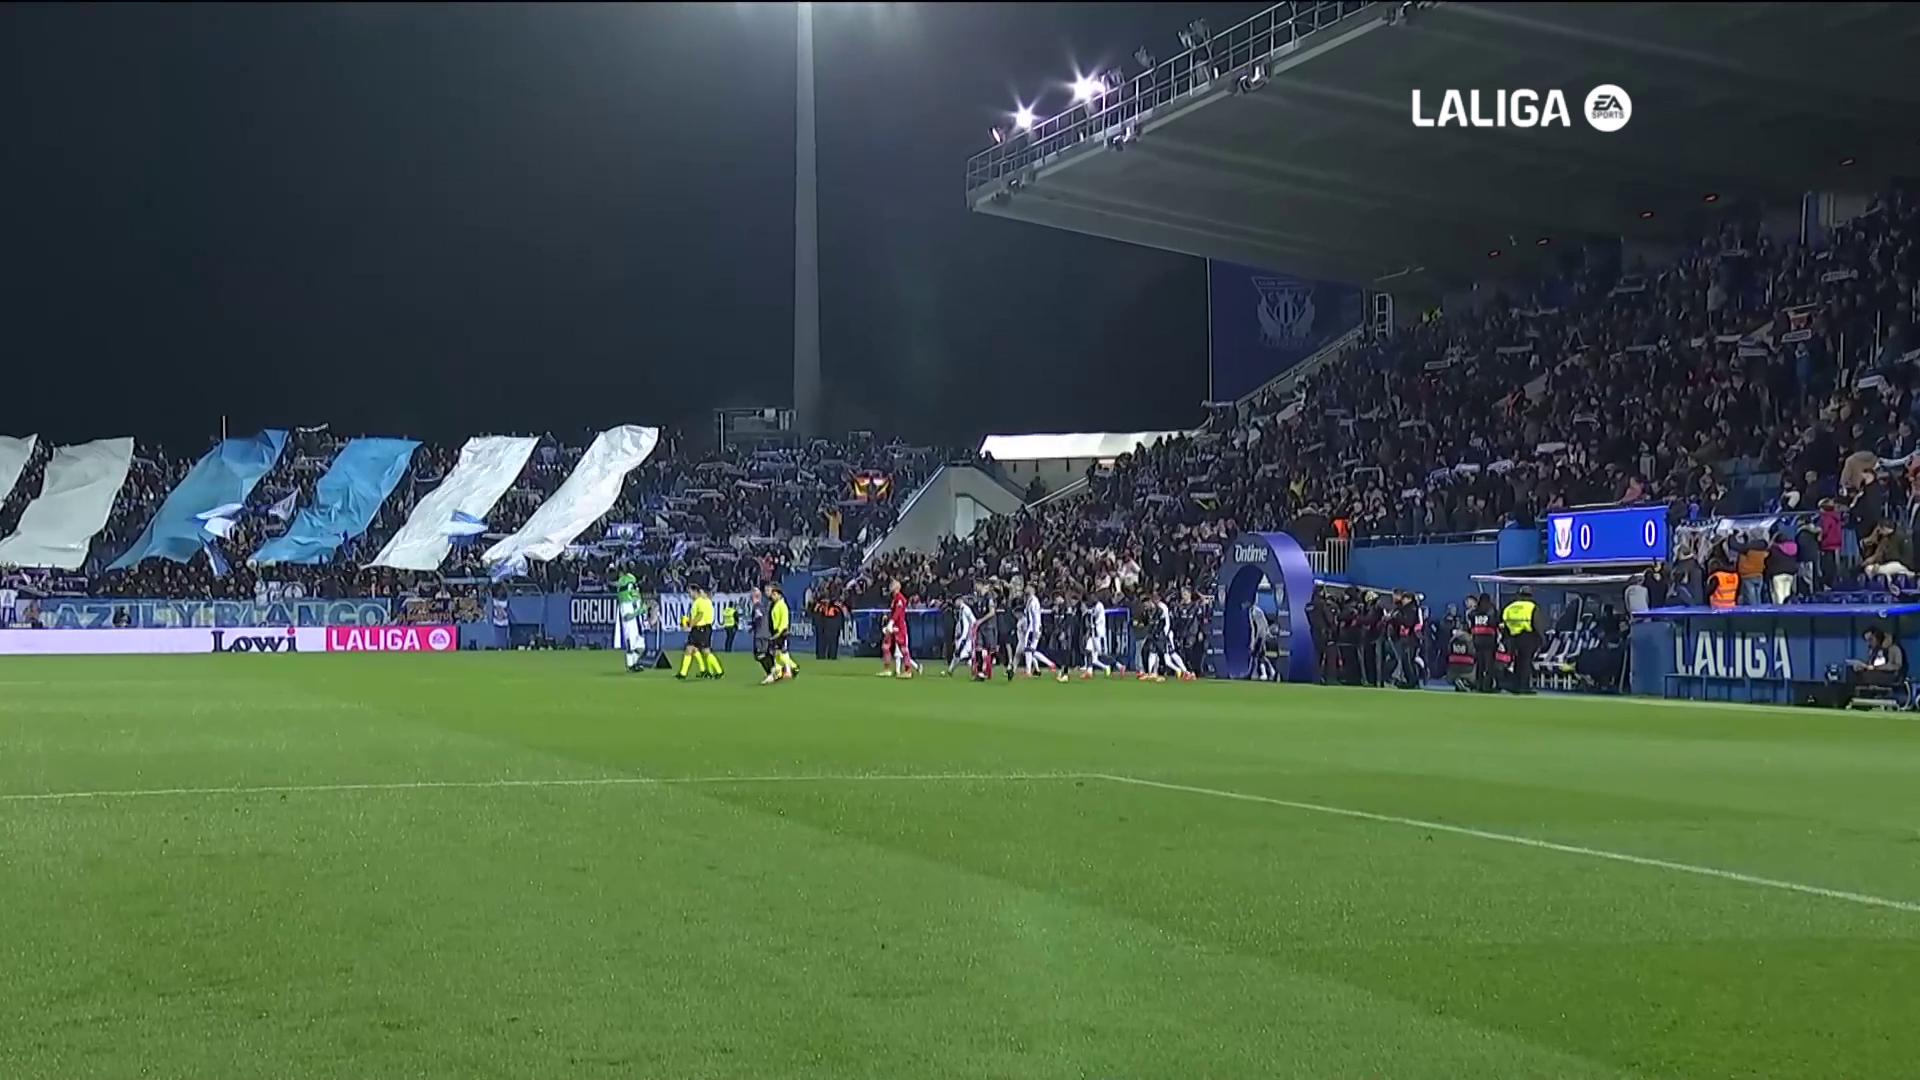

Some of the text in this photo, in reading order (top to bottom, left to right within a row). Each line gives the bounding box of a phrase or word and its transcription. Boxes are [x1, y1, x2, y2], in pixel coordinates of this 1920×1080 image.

[1581, 519, 1656, 550] 0 0
[211, 627, 299, 653] Lowi
[331, 628, 421, 651] LALIGA
[1675, 628, 1792, 679] LALIGA
